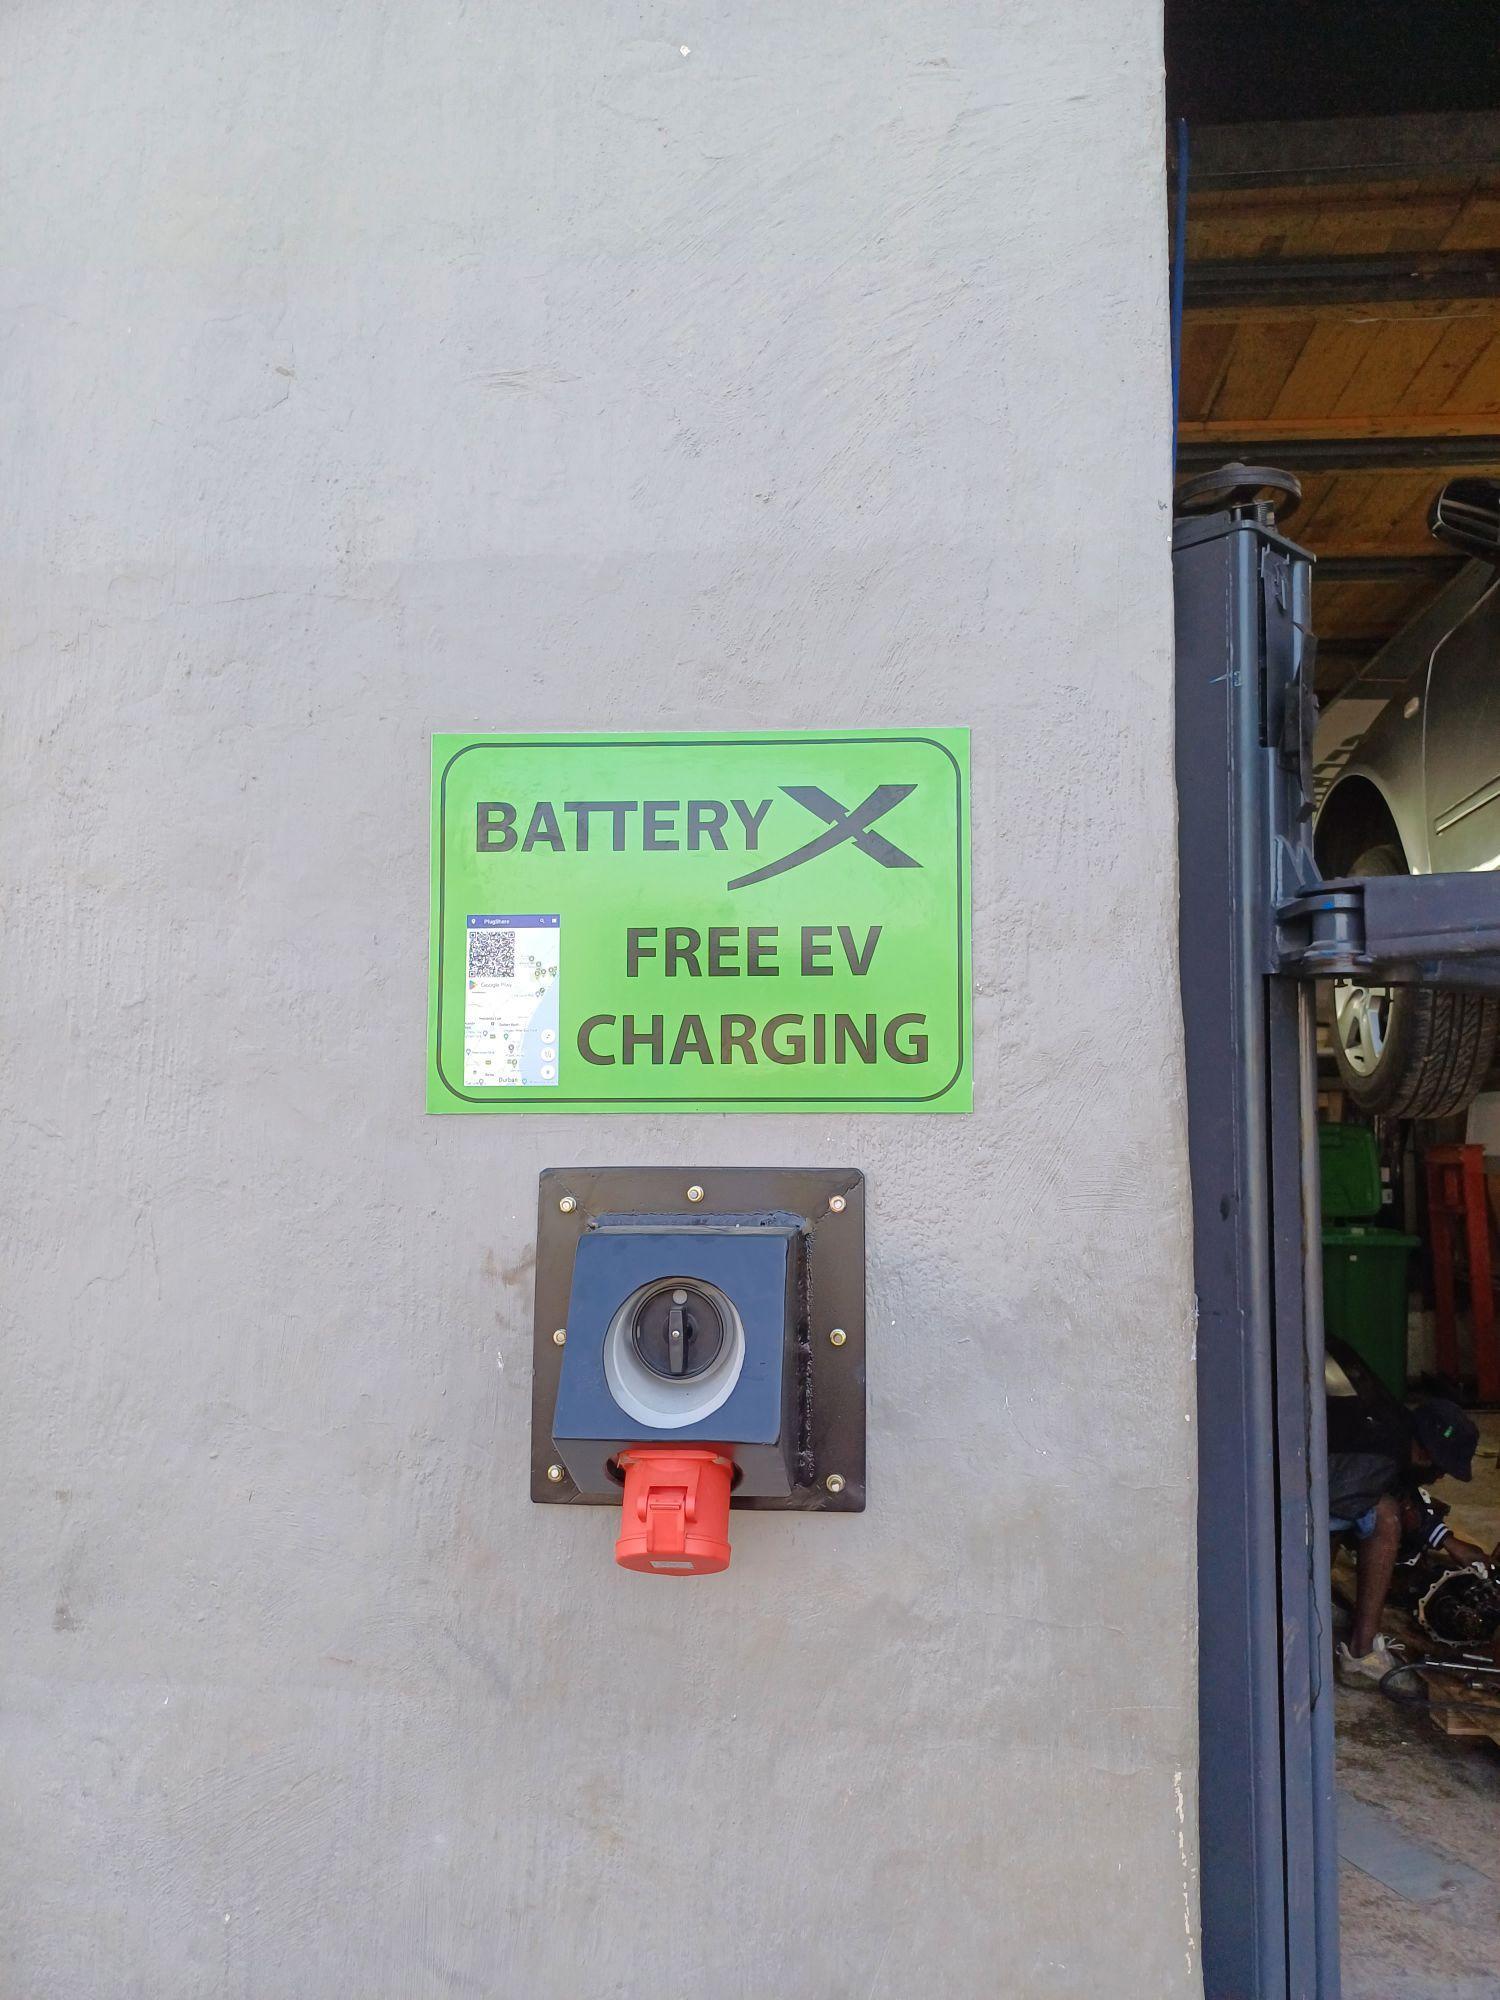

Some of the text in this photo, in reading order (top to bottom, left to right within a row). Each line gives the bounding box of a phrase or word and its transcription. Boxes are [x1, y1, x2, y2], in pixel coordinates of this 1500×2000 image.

[483, 918, 510, 926] PlugShare
[626, 925, 883, 978] FREE EV
[576, 1012, 929, 1066] CHARGING
